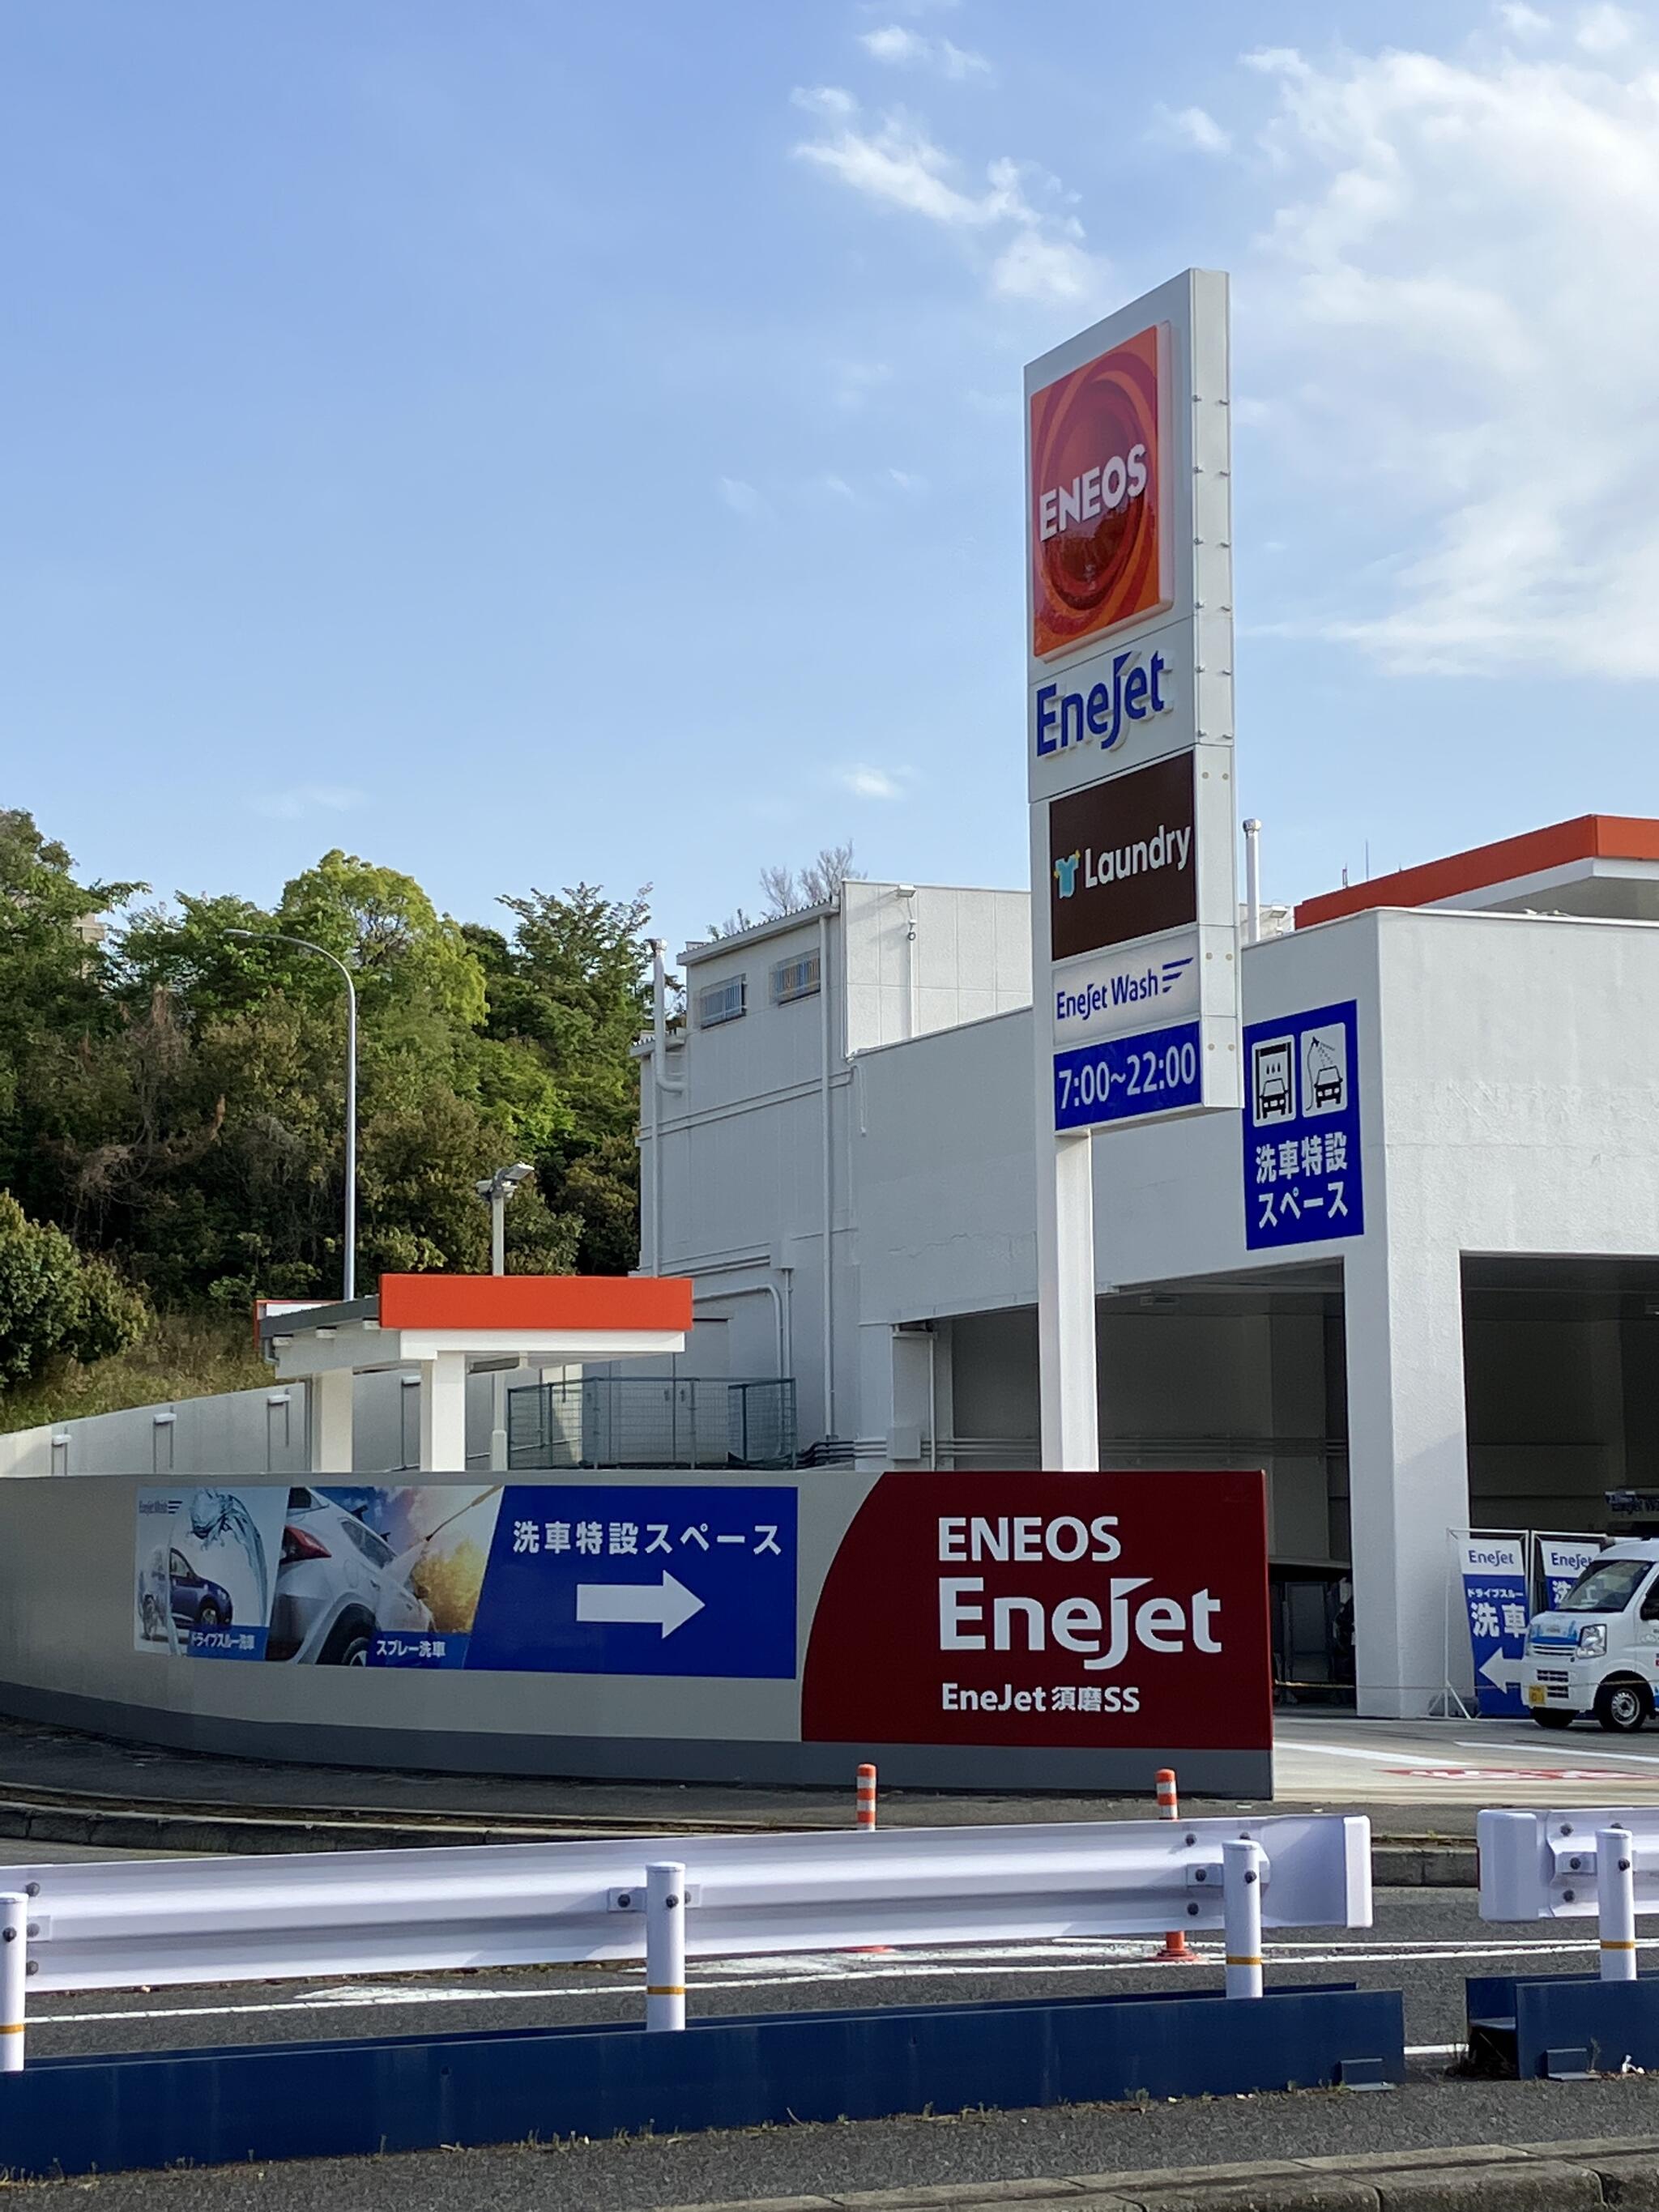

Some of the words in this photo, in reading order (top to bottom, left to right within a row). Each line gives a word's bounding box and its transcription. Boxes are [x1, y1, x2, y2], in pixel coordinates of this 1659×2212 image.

[1038, 443, 1147, 543] ENEOS
[1084, 825, 1192, 890] Laundry
[1110, 968, 1159, 1006] Wash
[1256, 1132, 1347, 1183] 洗車特設
[1258, 1181, 1348, 1229] スペース
[512, 1520, 782, 1555] 洗車特設スペース
[938, 1515, 1122, 1562] ENEOS
[1470, 1601, 1529, 1638] 洗車
[376, 1639, 446, 1658] スプレー洗車
[941, 1681, 1047, 1712] EneJet
[1051, 1686, 1141, 1713] 須磨SS
